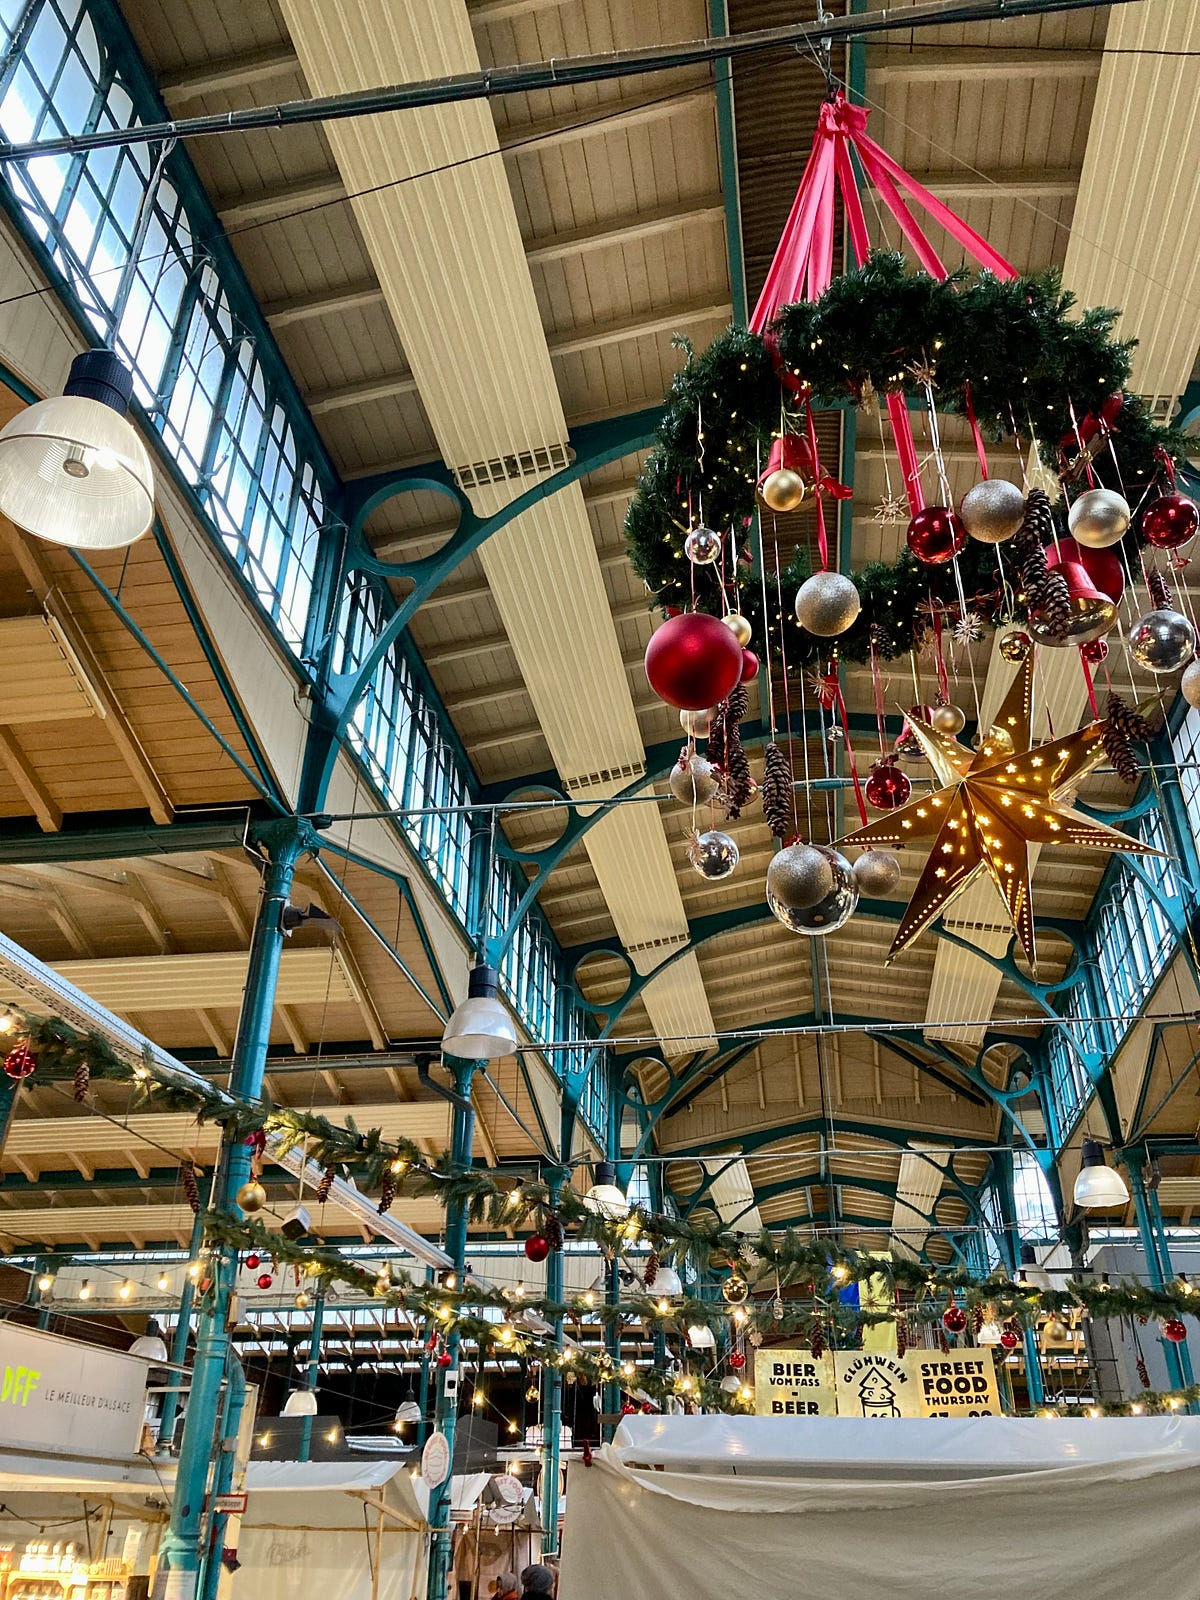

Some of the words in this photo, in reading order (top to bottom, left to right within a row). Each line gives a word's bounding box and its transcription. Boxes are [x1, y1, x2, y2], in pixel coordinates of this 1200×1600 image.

[773, 1363, 816, 1377] BIER
[844, 1356, 908, 1384] GLÜHWEIN
[920, 1361, 984, 1376] STREET
[769, 1377, 793, 1386] VOM
[795, 1378, 820, 1387] FASS
[922, 1376, 988, 1395] FOOD
[44, 1389, 56, 1402] LE
[56, 1391, 96, 1407] MEILLEUR
[97, 1397, 131, 1413] D'ALSACE
[771, 1400, 820, 1415] BEER
[925, 1395, 990, 1406] THURSDAY
